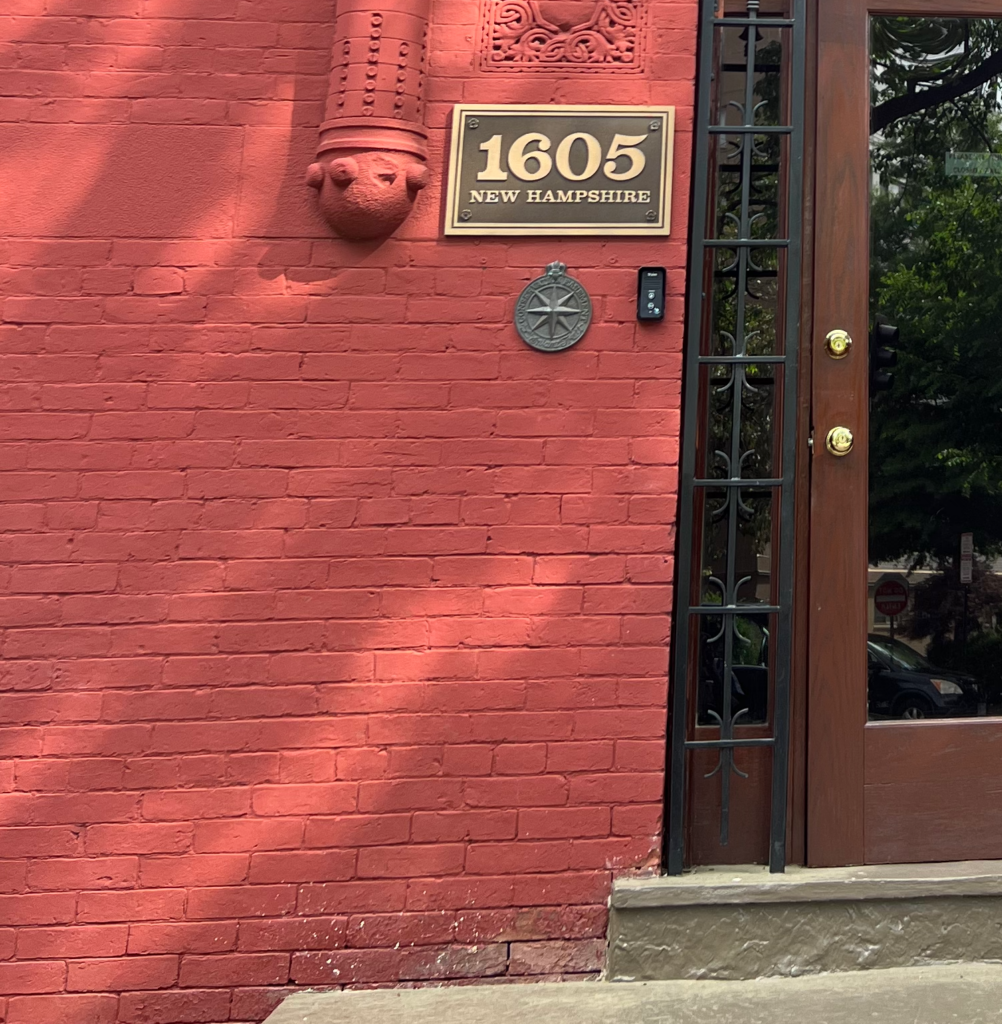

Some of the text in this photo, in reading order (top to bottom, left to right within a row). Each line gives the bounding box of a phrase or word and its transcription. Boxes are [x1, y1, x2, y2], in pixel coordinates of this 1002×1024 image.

[476, 132, 649, 181] 1605
[469, 190, 651, 204] NEW HAMPSHIRE
